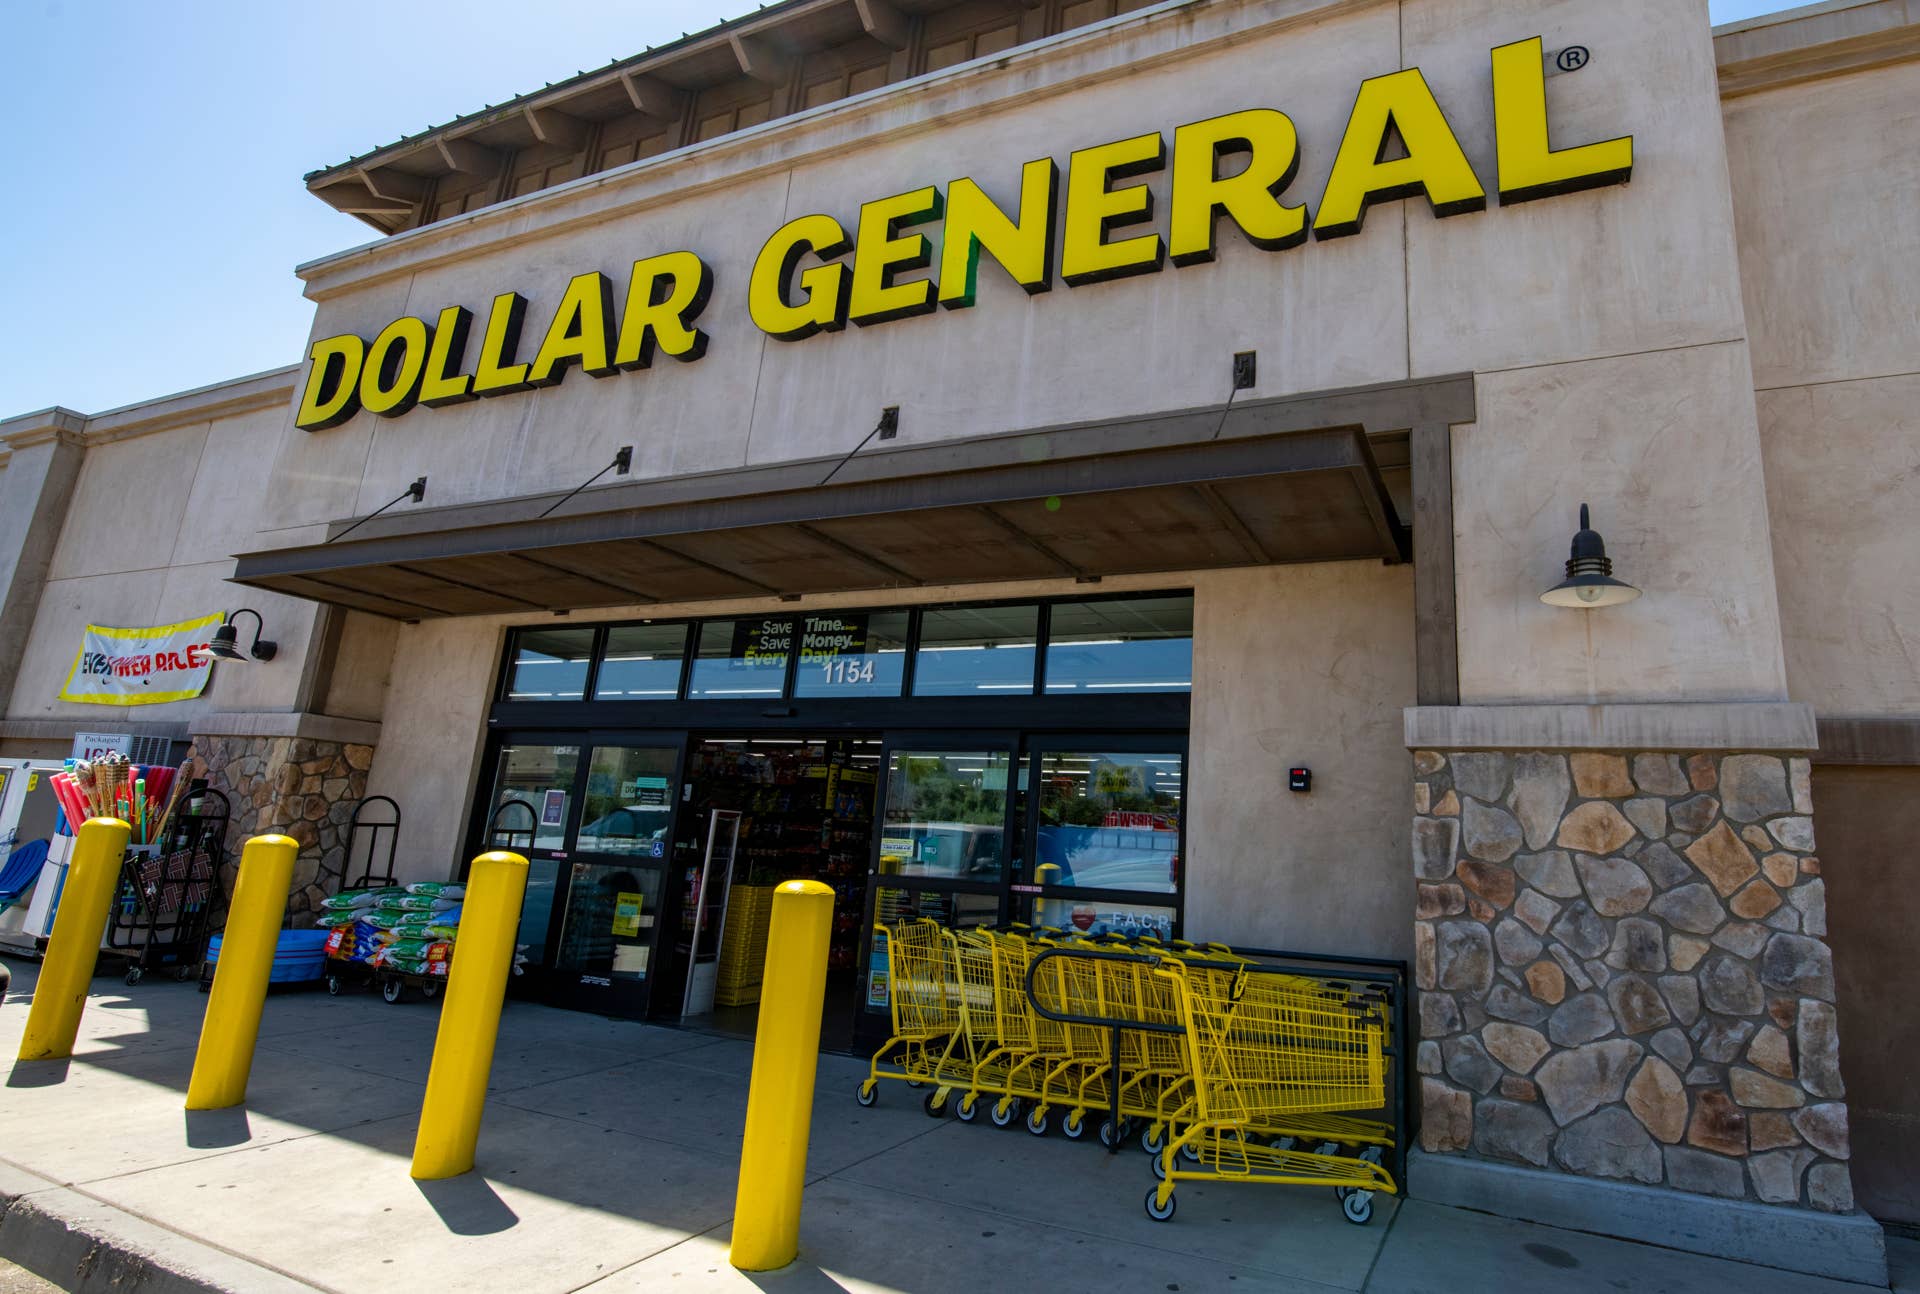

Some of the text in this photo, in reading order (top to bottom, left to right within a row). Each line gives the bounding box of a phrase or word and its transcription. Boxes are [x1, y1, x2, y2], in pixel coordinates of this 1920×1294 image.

[296, 251, 713, 431] DOLLAR
[748, 36, 1633, 341] GENERAL
[762, 620, 793, 635] Save
[804, 618, 845, 633] Time.
[759, 634, 853, 650] Save Money.
[744, 647, 839, 668] Every Day!
[824, 660, 874, 684] 1154
